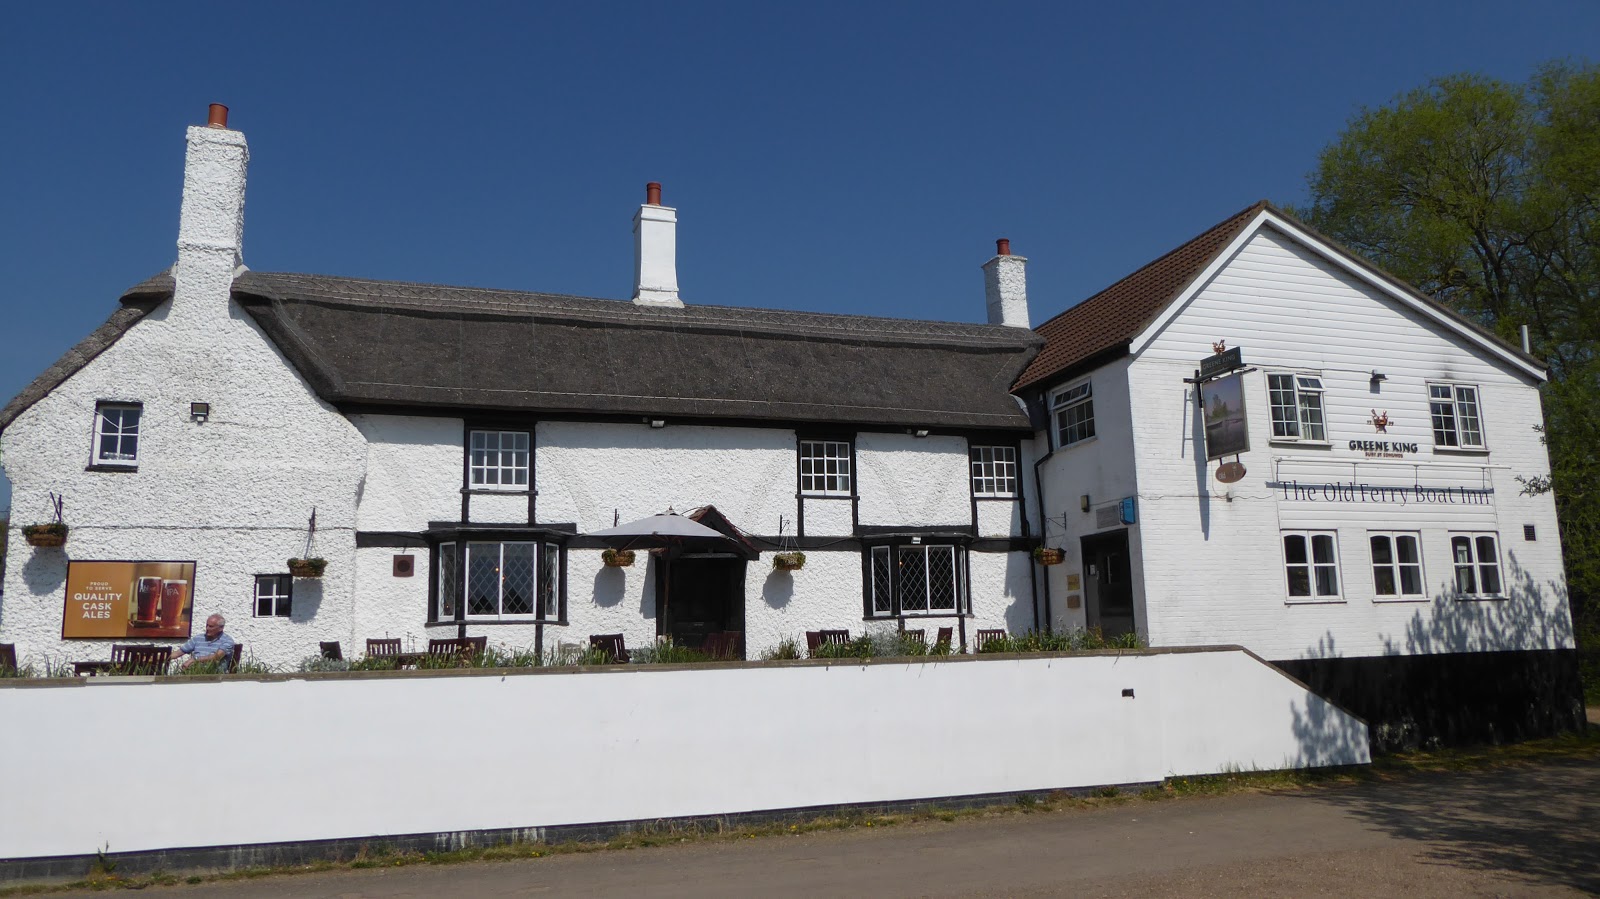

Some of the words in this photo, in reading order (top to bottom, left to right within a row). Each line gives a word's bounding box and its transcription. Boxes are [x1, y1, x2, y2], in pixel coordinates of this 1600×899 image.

[1202, 358, 1222, 370] GREENE
[1349, 440, 1389, 452] GREENE
[1392, 442, 1418, 453] KING
[1279, 480, 1317, 501] The
[1323, 482, 1355, 502] Old
[1359, 483, 1409, 506] Ferry
[1414, 484, 1456, 503] Boat
[1459, 486, 1490, 505] Inn
[166, 588, 179, 596] IPA
[74, 593, 122, 601] QUALITY
[82, 602, 112, 610] CASK
[82, 611, 111, 619] ALES
